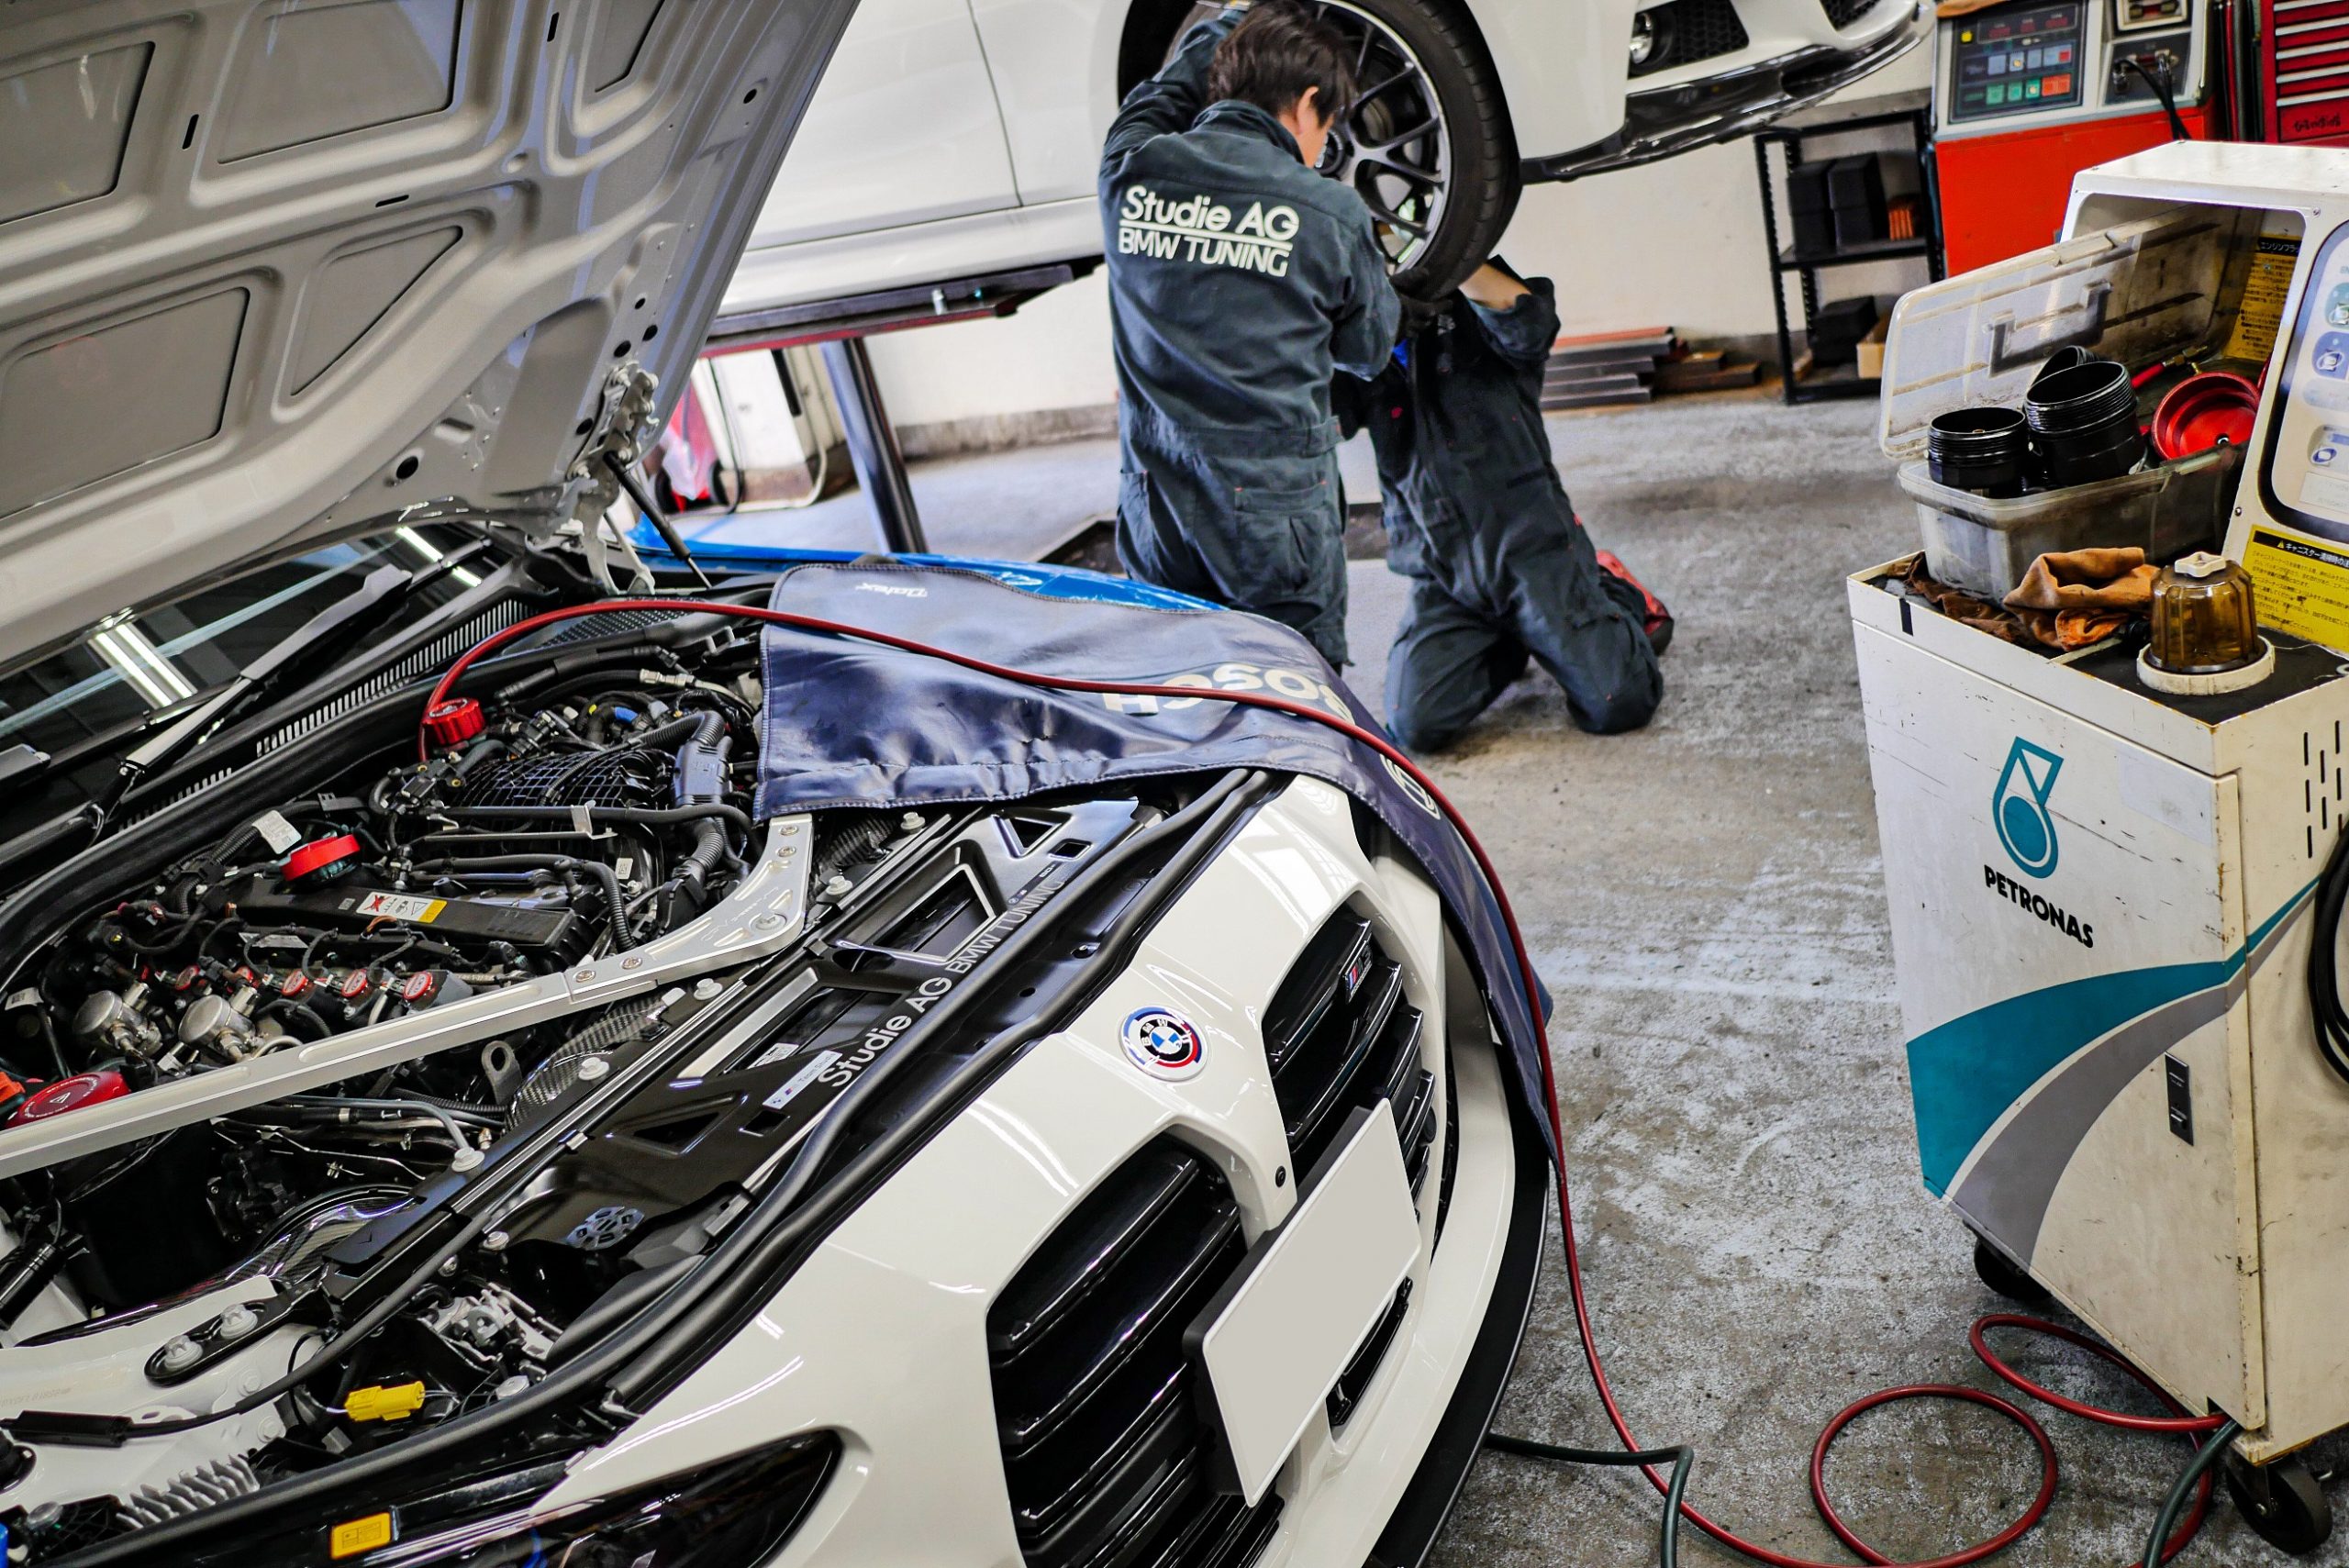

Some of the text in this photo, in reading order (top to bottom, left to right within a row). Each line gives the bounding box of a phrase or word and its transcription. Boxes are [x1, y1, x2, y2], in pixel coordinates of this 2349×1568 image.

[1119, 184, 1300, 242] Studie AG
[1119, 228, 1290, 278] BMW TUNING
[1984, 864, 2094, 950] PETRONAS
[818, 1014, 912, 1087] Studie
[905, 976, 952, 1013] AG
[944, 934, 1001, 974] BMW
[996, 880, 1066, 931] TUNING
